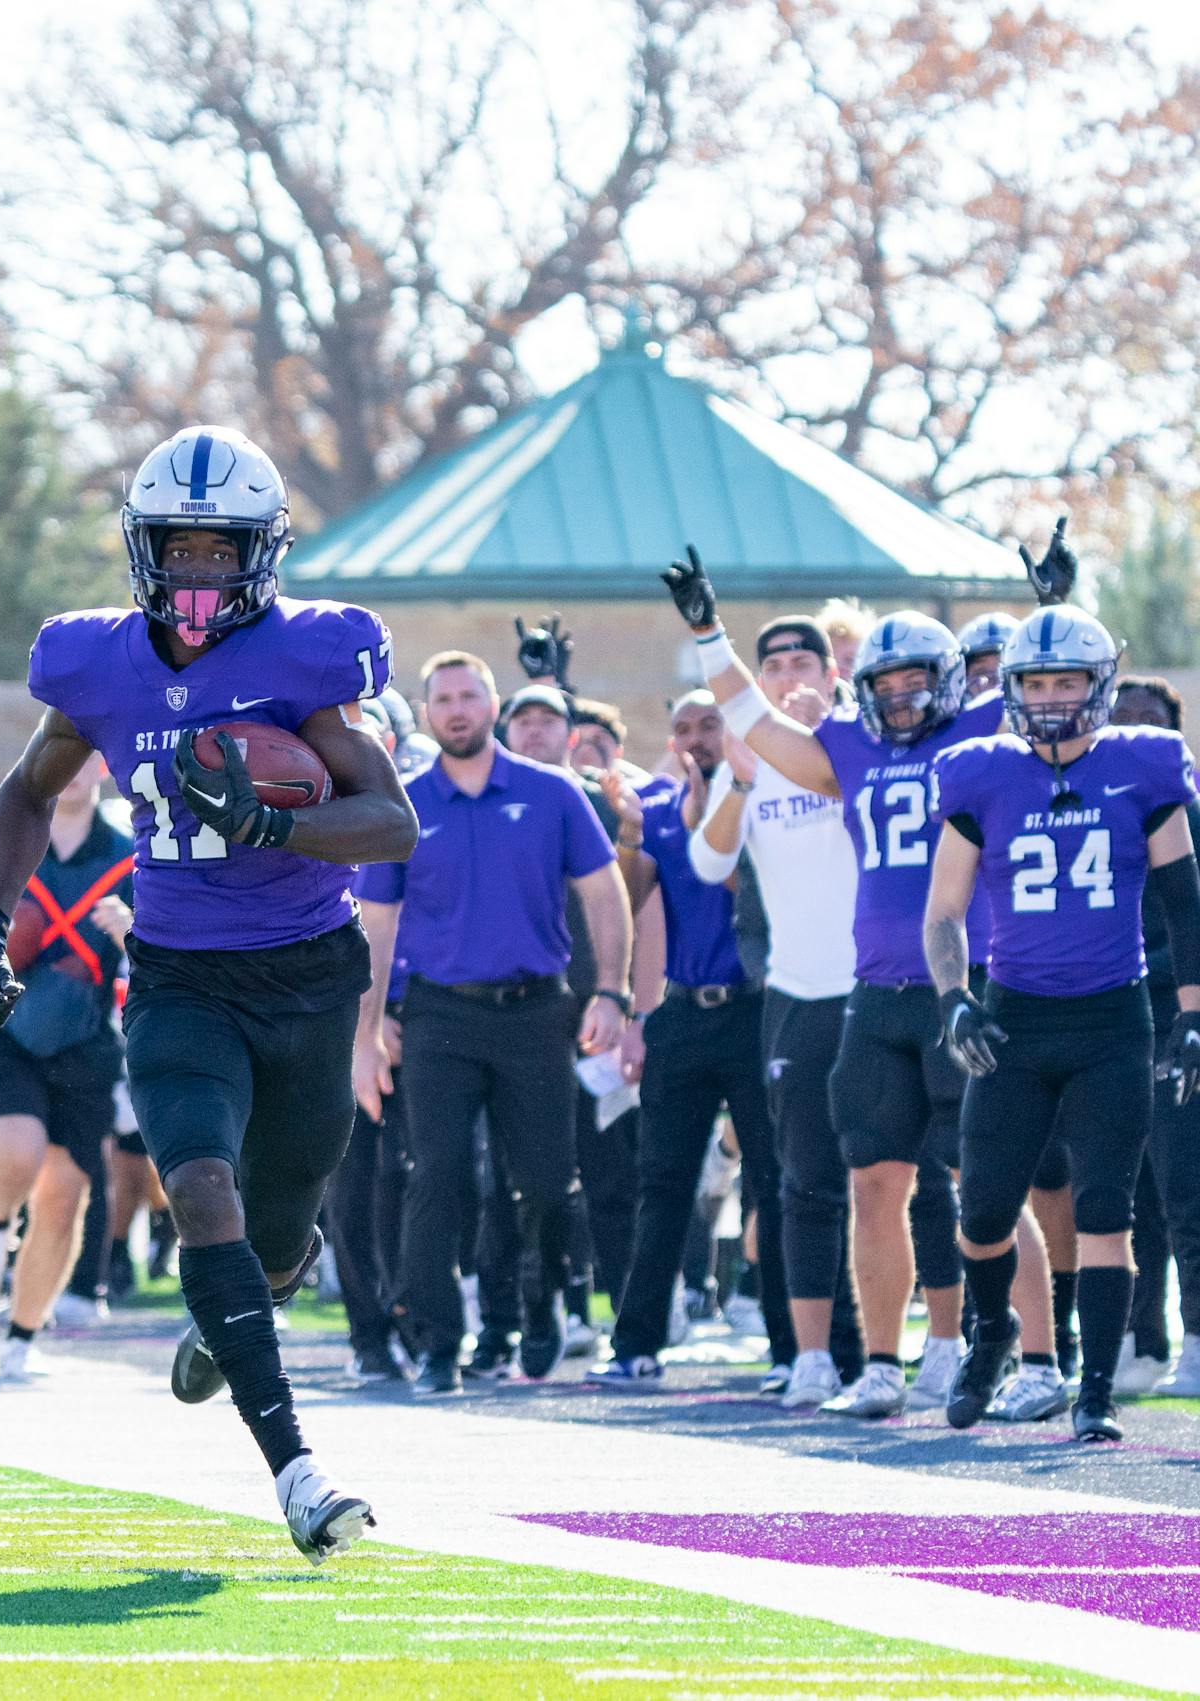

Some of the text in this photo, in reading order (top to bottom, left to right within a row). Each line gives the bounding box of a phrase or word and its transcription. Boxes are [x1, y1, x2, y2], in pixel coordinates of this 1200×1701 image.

[180, 502, 217, 513] TOMMIES
[357, 638, 392, 699] 17
[135, 732, 157, 752] ST.
[855, 781, 928, 870] 12
[1010, 829, 1116, 912] 24
